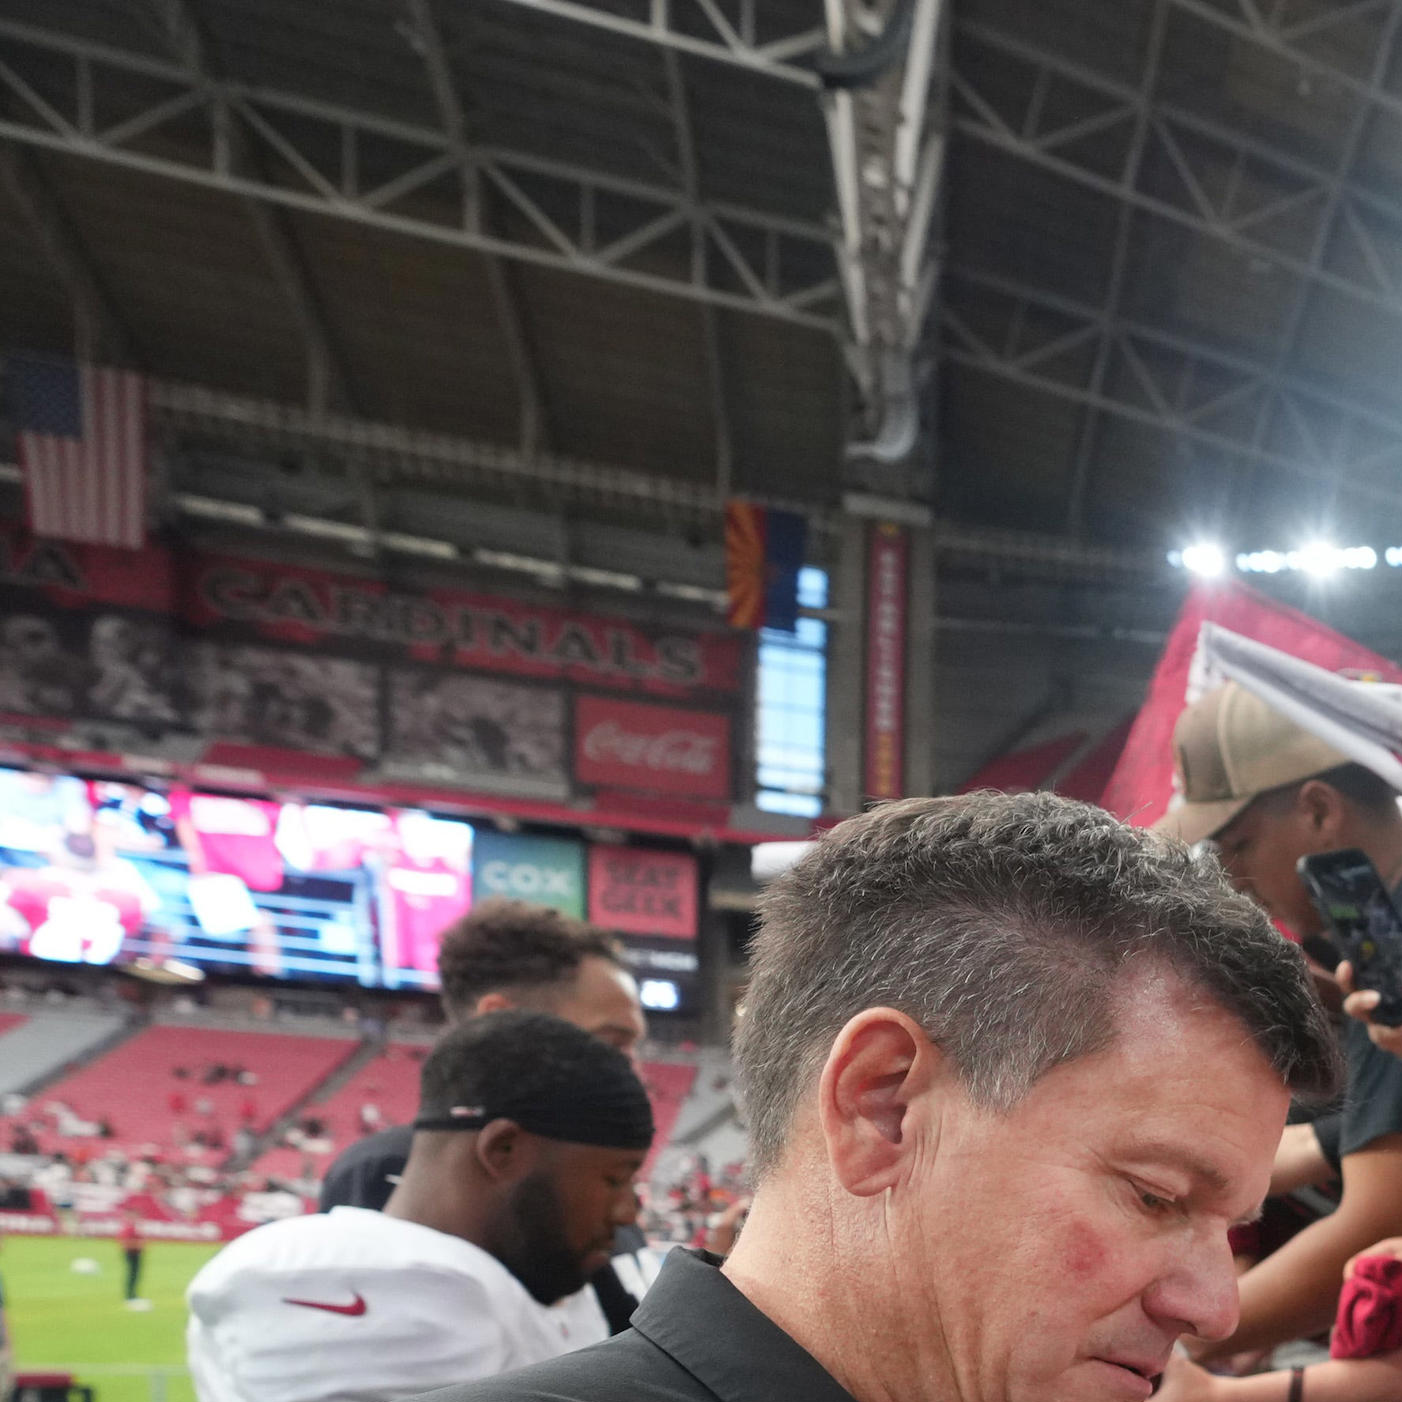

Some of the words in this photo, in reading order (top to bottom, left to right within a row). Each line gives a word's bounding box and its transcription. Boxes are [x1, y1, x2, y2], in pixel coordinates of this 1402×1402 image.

[206, 566, 704, 685] CARDINALS
[583, 720, 719, 776] Coca-Cola
[481, 860, 571, 894] COX
[602, 858, 684, 890] SEAT
[602, 886, 682, 917] GEEK
